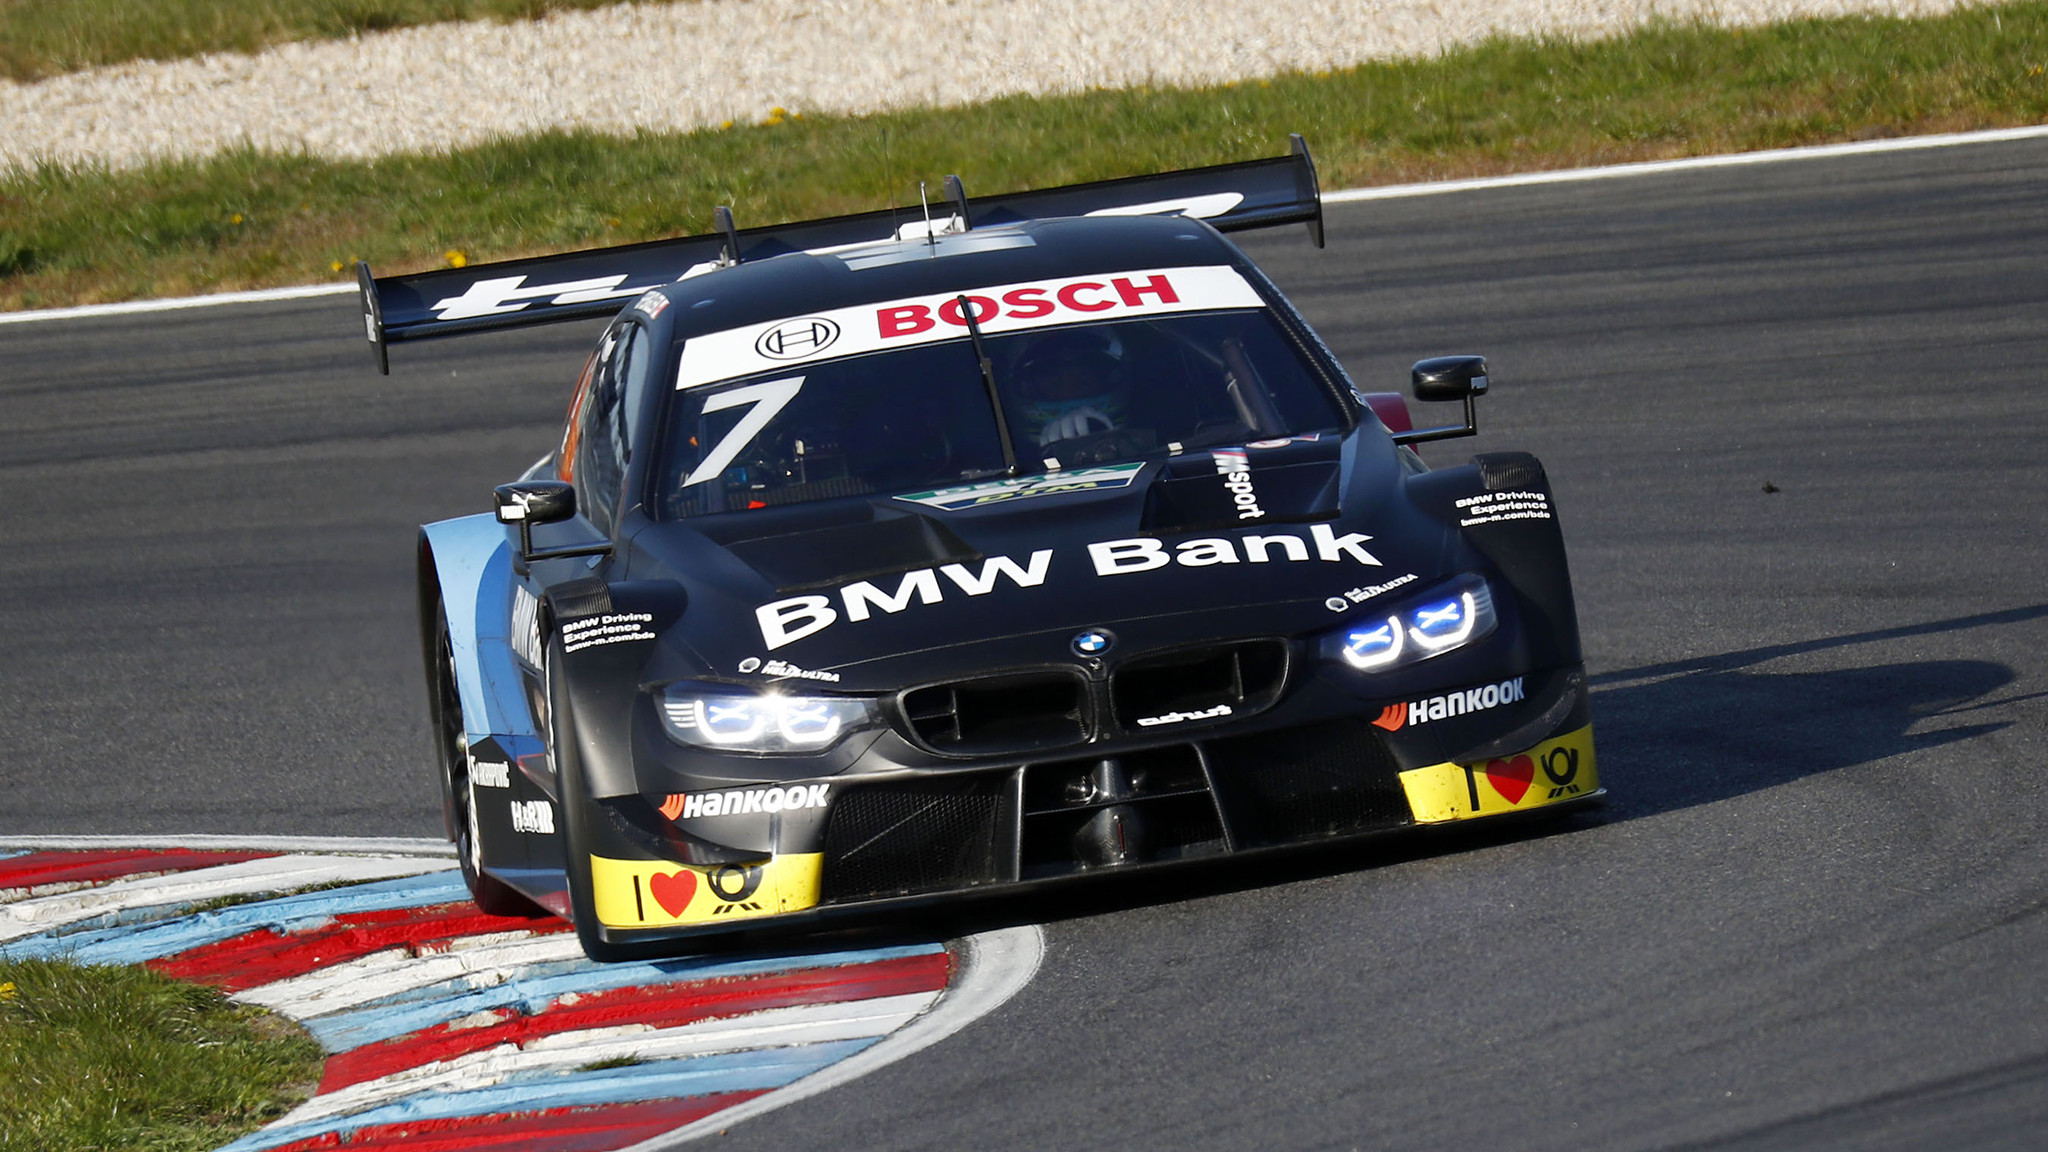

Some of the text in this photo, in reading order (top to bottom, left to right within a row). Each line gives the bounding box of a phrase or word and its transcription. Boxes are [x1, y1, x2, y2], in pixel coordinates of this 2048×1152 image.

[876, 274, 1180, 339] BOSCH
[681, 375, 807, 488] 7
[975, 481, 1099, 503] DTM
[1455, 491, 1546, 508] BMW Driving
[1460, 510, 1551, 527] bmw-m.com/bde
[1470, 501, 1548, 515] Experience
[755, 523, 1383, 651] BMW Bank
[562, 612, 653, 634] BMW Driving
[563, 623, 642, 644] Experience
[565, 631, 656, 653] bmw-m.com/bde
